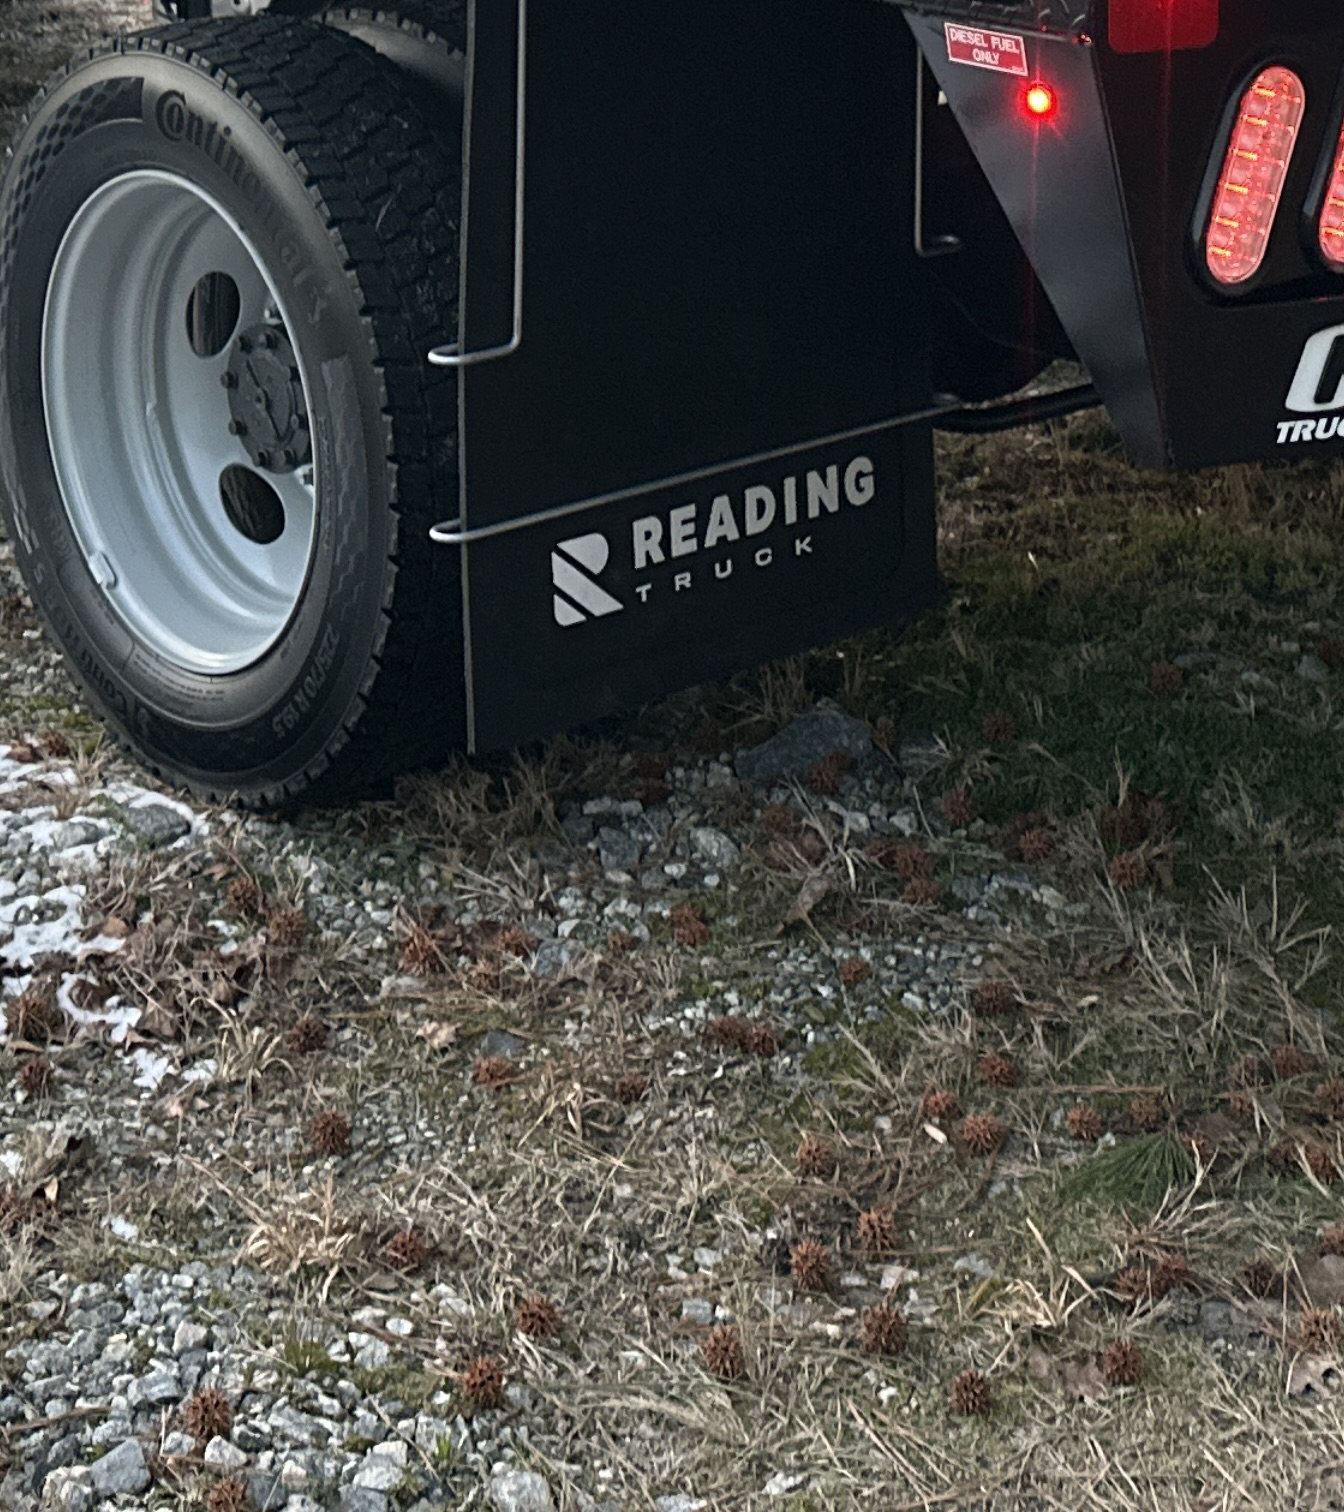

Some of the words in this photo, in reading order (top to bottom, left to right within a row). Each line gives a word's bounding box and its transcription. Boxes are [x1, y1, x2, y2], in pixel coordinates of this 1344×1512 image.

[949, 27, 988, 48] DIESEL
[990, 36, 1020, 54] FUEL
[972, 48, 999, 65] ONLY
[632, 456, 875, 570] READING
[635, 536, 813, 603] TRUCK
